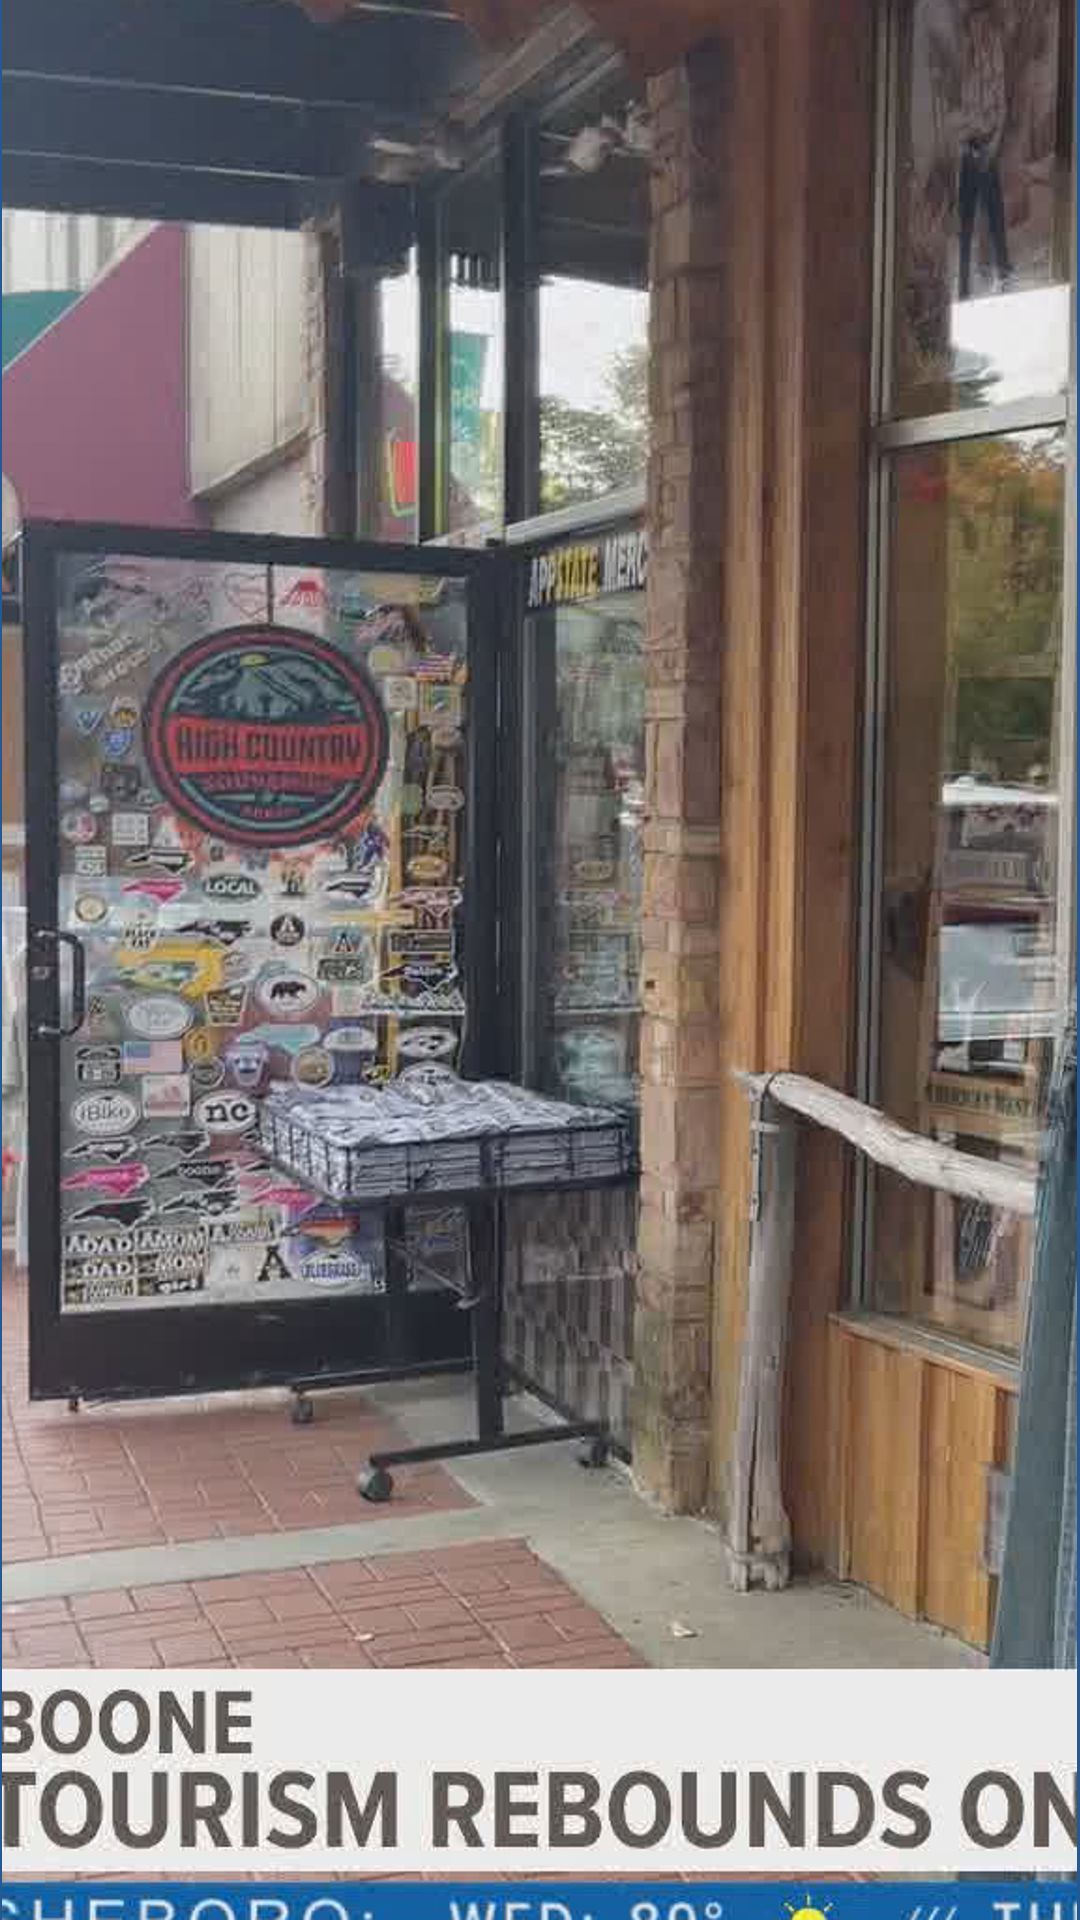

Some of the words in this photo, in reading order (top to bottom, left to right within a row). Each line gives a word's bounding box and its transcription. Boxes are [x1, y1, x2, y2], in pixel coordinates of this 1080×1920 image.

[177, 724, 238, 763] HIGH
[245, 730, 359, 765] COUNTRY
[205, 878, 257, 896] LOCAL
[205, 1102, 249, 1122] nc
